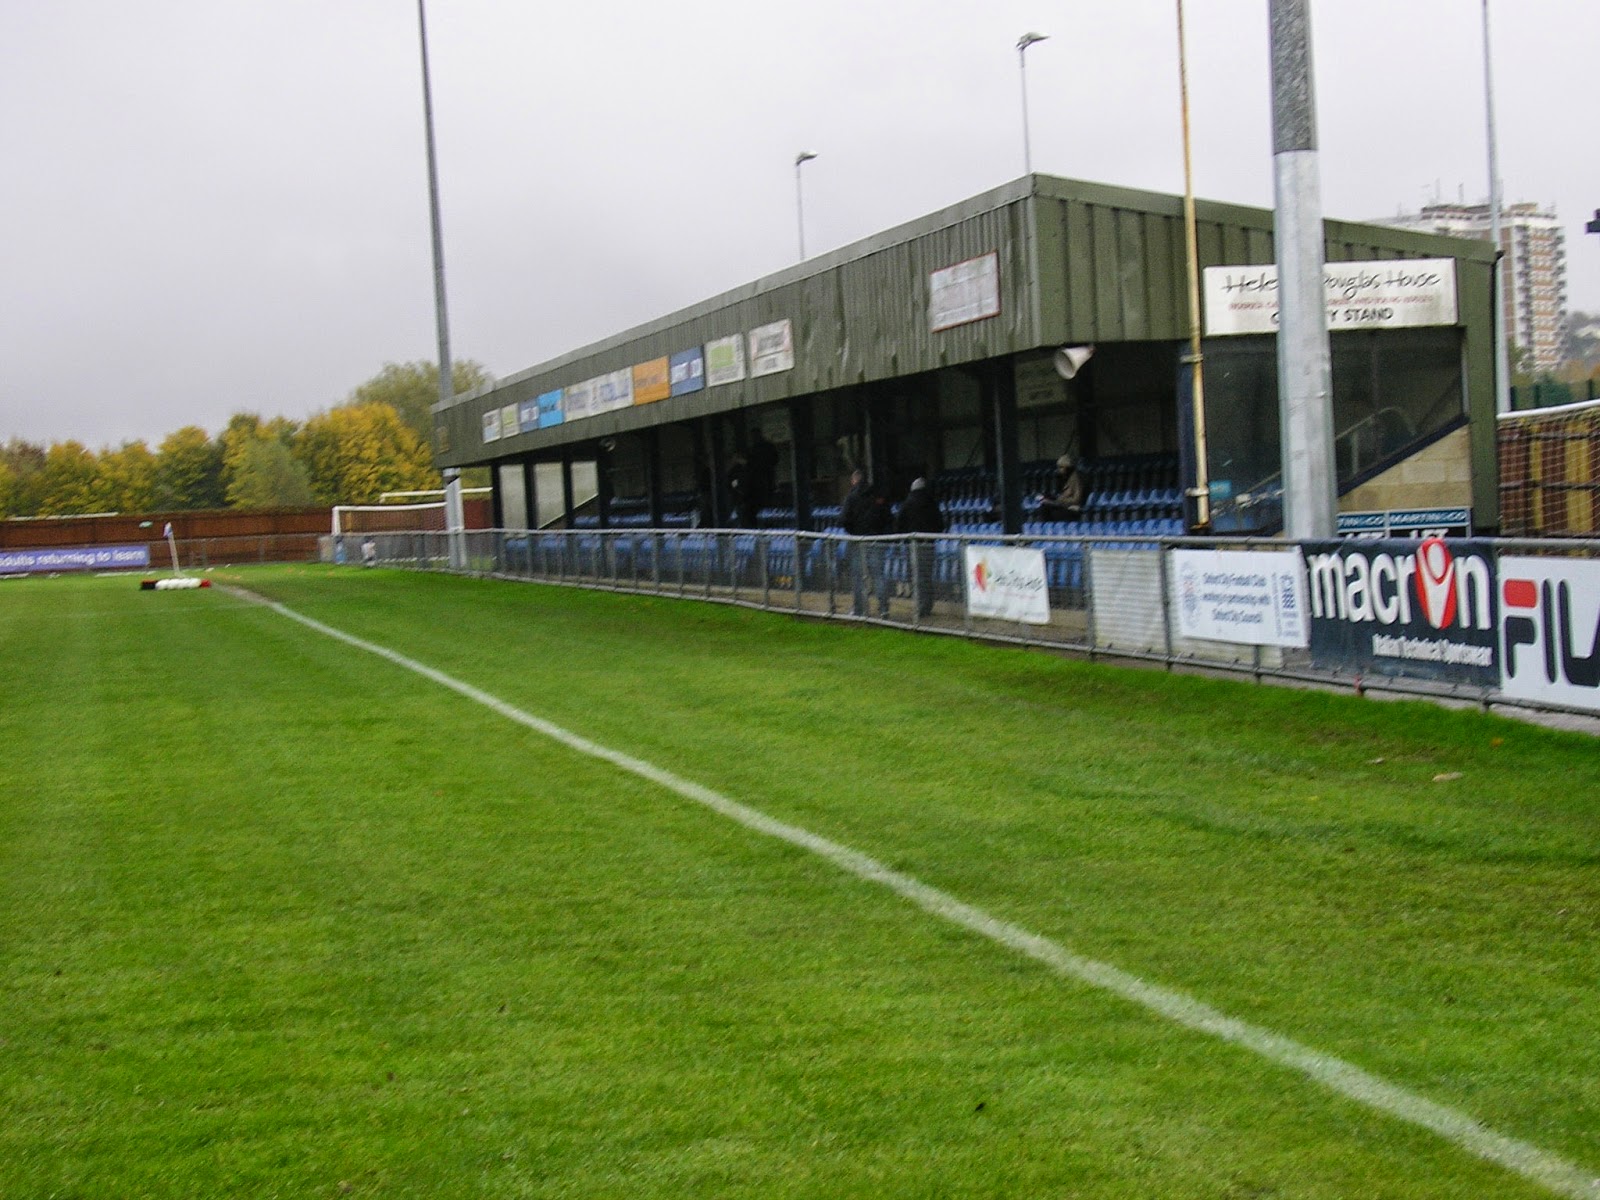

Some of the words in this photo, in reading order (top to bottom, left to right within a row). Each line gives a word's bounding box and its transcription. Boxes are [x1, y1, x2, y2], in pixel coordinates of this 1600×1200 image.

[1221, 272, 1280, 293] Hele
[1323, 270, 1380, 300] ouglas
[1385, 270, 1441, 288] House
[1343, 307, 1394, 322] STAND
[37, 552, 95, 565] returning
[97, 550, 112, 562] to
[113, 550, 145, 561] learn
[1308, 538, 1492, 630] macron
[1503, 578, 1600, 687] FIL
